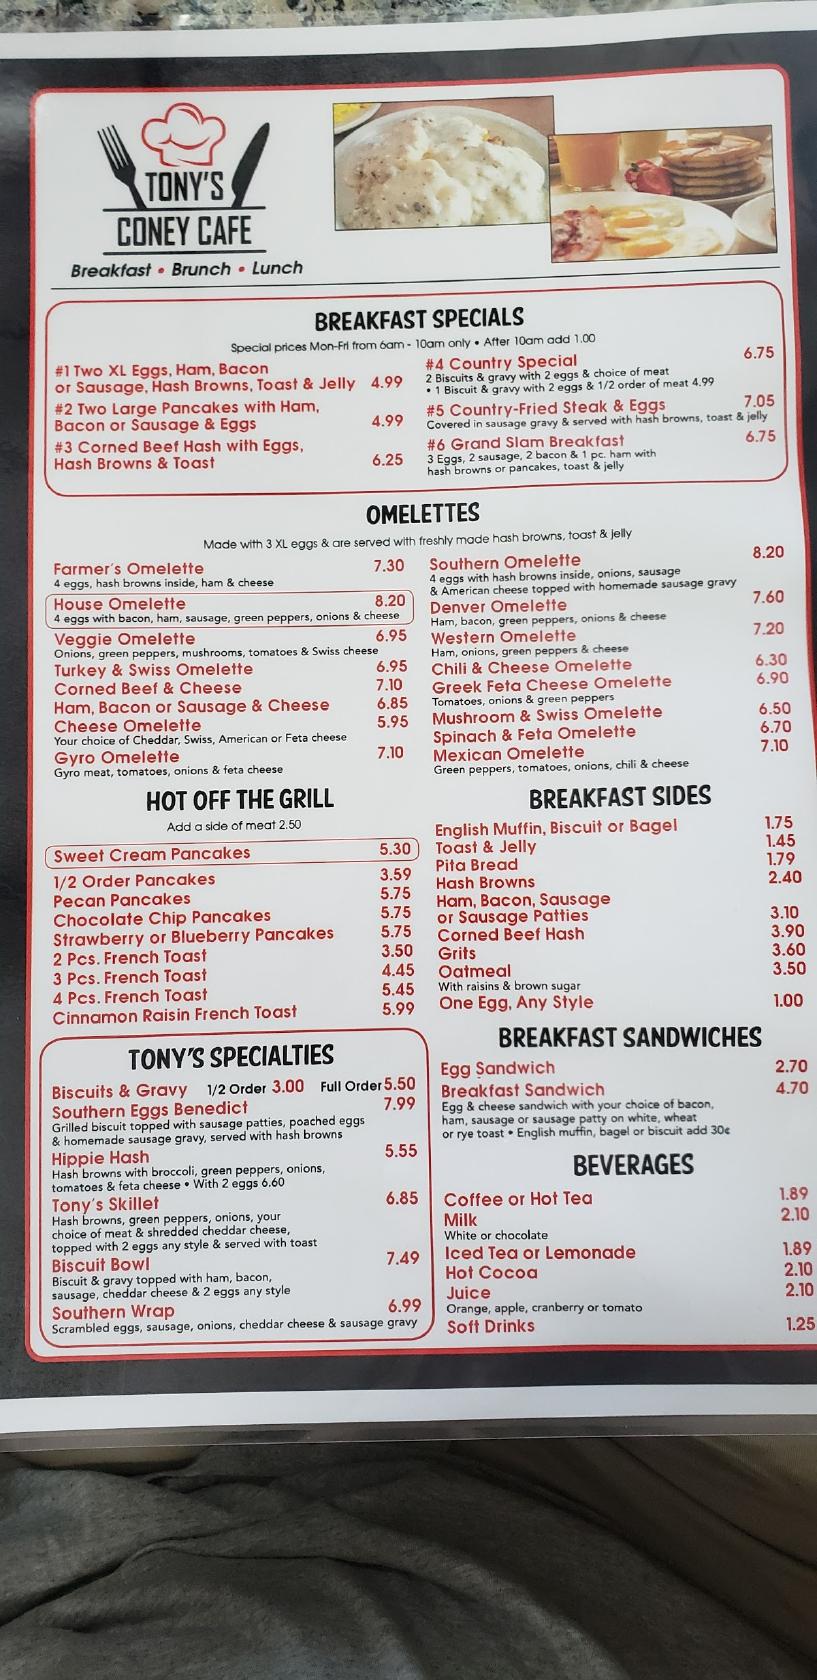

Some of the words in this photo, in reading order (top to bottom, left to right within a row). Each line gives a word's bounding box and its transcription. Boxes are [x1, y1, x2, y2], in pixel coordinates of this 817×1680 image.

[144, 171, 224, 202] TONY'S
[117, 215, 190, 247] CONEY
[198, 215, 252, 246] CAFE
[70, 262, 152, 278] Breakfast
[171, 261, 231, 277] Brunch
[252, 260, 303, 275] Lunch
[315, 309, 427, 332] BREAKFAST
[432, 306, 524, 329] SPECIALS
[231, 342, 272, 354] Special
[274, 342, 307, 354] prices
[309, 340, 349, 352] Mon-Fri
[351, 340, 377, 351] from
[379, 340, 404, 350] 6am
[416, 338, 445, 349] 10am
[449, 338, 471, 351] only
[483, 336, 510, 347] After
[514, 335, 544, 346] 10am
[546, 334, 571, 345] add
[574, 333, 596, 344] 1.00
[743, 345, 775, 360] 6.75
[425, 357, 444, 371] #4
[449, 356, 512, 372] Country
[517, 353, 577, 371] Special
[55, 364, 69, 377] #1
[73, 364, 103, 377] Two
[108, 364, 127, 377] XL
[132, 364, 172, 380] Eggs,
[176, 363, 215, 377] Ham,
[219, 362, 269, 375] Bacon
[54, 383, 71, 394] or
[76, 381, 148, 397] Sausage,
[152, 379, 190, 393] Hash
[194, 379, 253, 393] Browns,
[256, 377, 298, 391] Toast
[302, 377, 314, 391] &
[319, 376, 356, 392] Jelly
[371, 375, 403, 389] 4.99
[426, 404, 445, 417] #5
[449, 401, 558, 419] Country-Fried
[563, 399, 608, 415] Steak
[613, 398, 624, 413] &
[629, 398, 666, 417] Eggs
[744, 394, 775, 408] 7.05
[426, 418, 471, 430] Covered
[473, 419, 483, 429] in
[485, 420, 527, 431] sausage
[530, 419, 559, 430] gravy
[561, 416, 570, 427] &
[572, 415, 608, 427] served
[610, 414, 633, 425] with
[635, 412, 659, 424] hash
[662, 413, 703, 424] browns,
[706, 413, 733, 422] toast
[736, 411, 744, 421] &
[747, 409, 768, 424] jelly
[366, 501, 480, 526] OMELETTES
[752, 545, 785, 559] 8.20
[54, 562, 122, 576] Farmer's
[126, 562, 204, 575] Omelette
[374, 558, 405, 572] 7.30
[429, 557, 499, 571] Southern
[504, 553, 581, 569] Omelette
[54, 578, 61, 588] 4
[63, 581, 92, 591] eggs,
[96, 578, 120, 588] hash
[122, 577, 162, 588] browns
[164, 577, 199, 589] inside,
[201, 577, 224, 588] ham
[226, 577, 235, 588] &
[237, 577, 275, 588] cheese
[54, 597, 103, 611] House
[108, 596, 186, 611] Omelette
[375, 593, 406, 608] 8.20
[753, 589, 784, 604] 7.60
[430, 601, 486, 615] Denver
[490, 598, 567, 614] Omelette
[760, 738, 789, 752] 7.10
[433, 748, 502, 762] Mexican
[506, 745, 585, 761] Omelette
[146, 790, 188, 812] HOT
[193, 789, 231, 811] OFF
[235, 788, 275, 810] THE
[279, 787, 334, 810] GRILL
[529, 785, 647, 810] BREAKFAST
[652, 784, 712, 807] SIDES
[166, 821, 192, 832] Add
[194, 823, 203, 832] a
[205, 820, 229, 832] side
[231, 820, 244, 831] of
[245, 819, 277, 831] meat
[278, 819, 302, 830] 2.50
[435, 822, 489, 840] English
[493, 821, 546, 837] Muffin,
[550, 819, 603, 835] Biscuit
[607, 822, 624, 833] or
[629, 818, 677, 836] Bagel
[764, 815, 793, 830] 1.75
[54, 848, 105, 864] Sweet
[109, 848, 167, 863] Cream
[171, 845, 251, 861] Pancakes
[379, 842, 411, 856] 5.30
[53, 952, 62, 967] 2
[67, 952, 100, 966] Pcs.
[104, 950, 159, 965] French
[163, 948, 207, 964] Toast
[381, 943, 413, 958] 3.50
[438, 946, 476, 961] Grits
[772, 942, 806, 957] 3.60
[438, 963, 511, 979] Oatmeal
[773, 961, 807, 976] 3.50
[438, 981, 463, 992] With
[466, 981, 500, 992] raisins
[502, 980, 511, 991] &
[514, 979, 548, 991] brown
[551, 983, 581, 993] sugar
[499, 1027, 618, 1048] BREAKFAST
[622, 1026, 762, 1048] SANDWICHES
[128, 1046, 205, 1071] TONY'S
[210, 1043, 334, 1069] SPECIALTIES
[440, 1061, 471, 1079] Egg
[476, 1060, 555, 1076] Sandwich
[775, 1059, 808, 1073] 2.70
[385, 1143, 418, 1158] 5.55
[52, 1151, 105, 1169] Hippie
[109, 1149, 150, 1165] Hash
[573, 1152, 694, 1177] BEVERAGES
[52, 1197, 104, 1215] Tony's
[108, 1195, 159, 1212] Skillet
[386, 1190, 419, 1206] 6.85
[444, 1212, 478, 1227] Milk
[780, 1206, 810, 1222] 2.10
[444, 1229, 477, 1241] White
[480, 1232, 492, 1241] or
[495, 1229, 548, 1241] chocolate
[52, 1321, 110, 1335] Scrambled
[113, 1324, 143, 1335] eggs,
[146, 1323, 194, 1334] sausage,
[197, 1320, 236, 1332] onions,
[239, 1318, 284, 1330] cheddar
[287, 1317, 325, 1329] cheese
[328, 1317, 337, 1329] &
[340, 1319, 384, 1330] sausage
[387, 1319, 418, 1330] gravy
[447, 1319, 480, 1334] Soft
[484, 1318, 535, 1334] Drinks
[786, 1316, 816, 1332] 1.25
